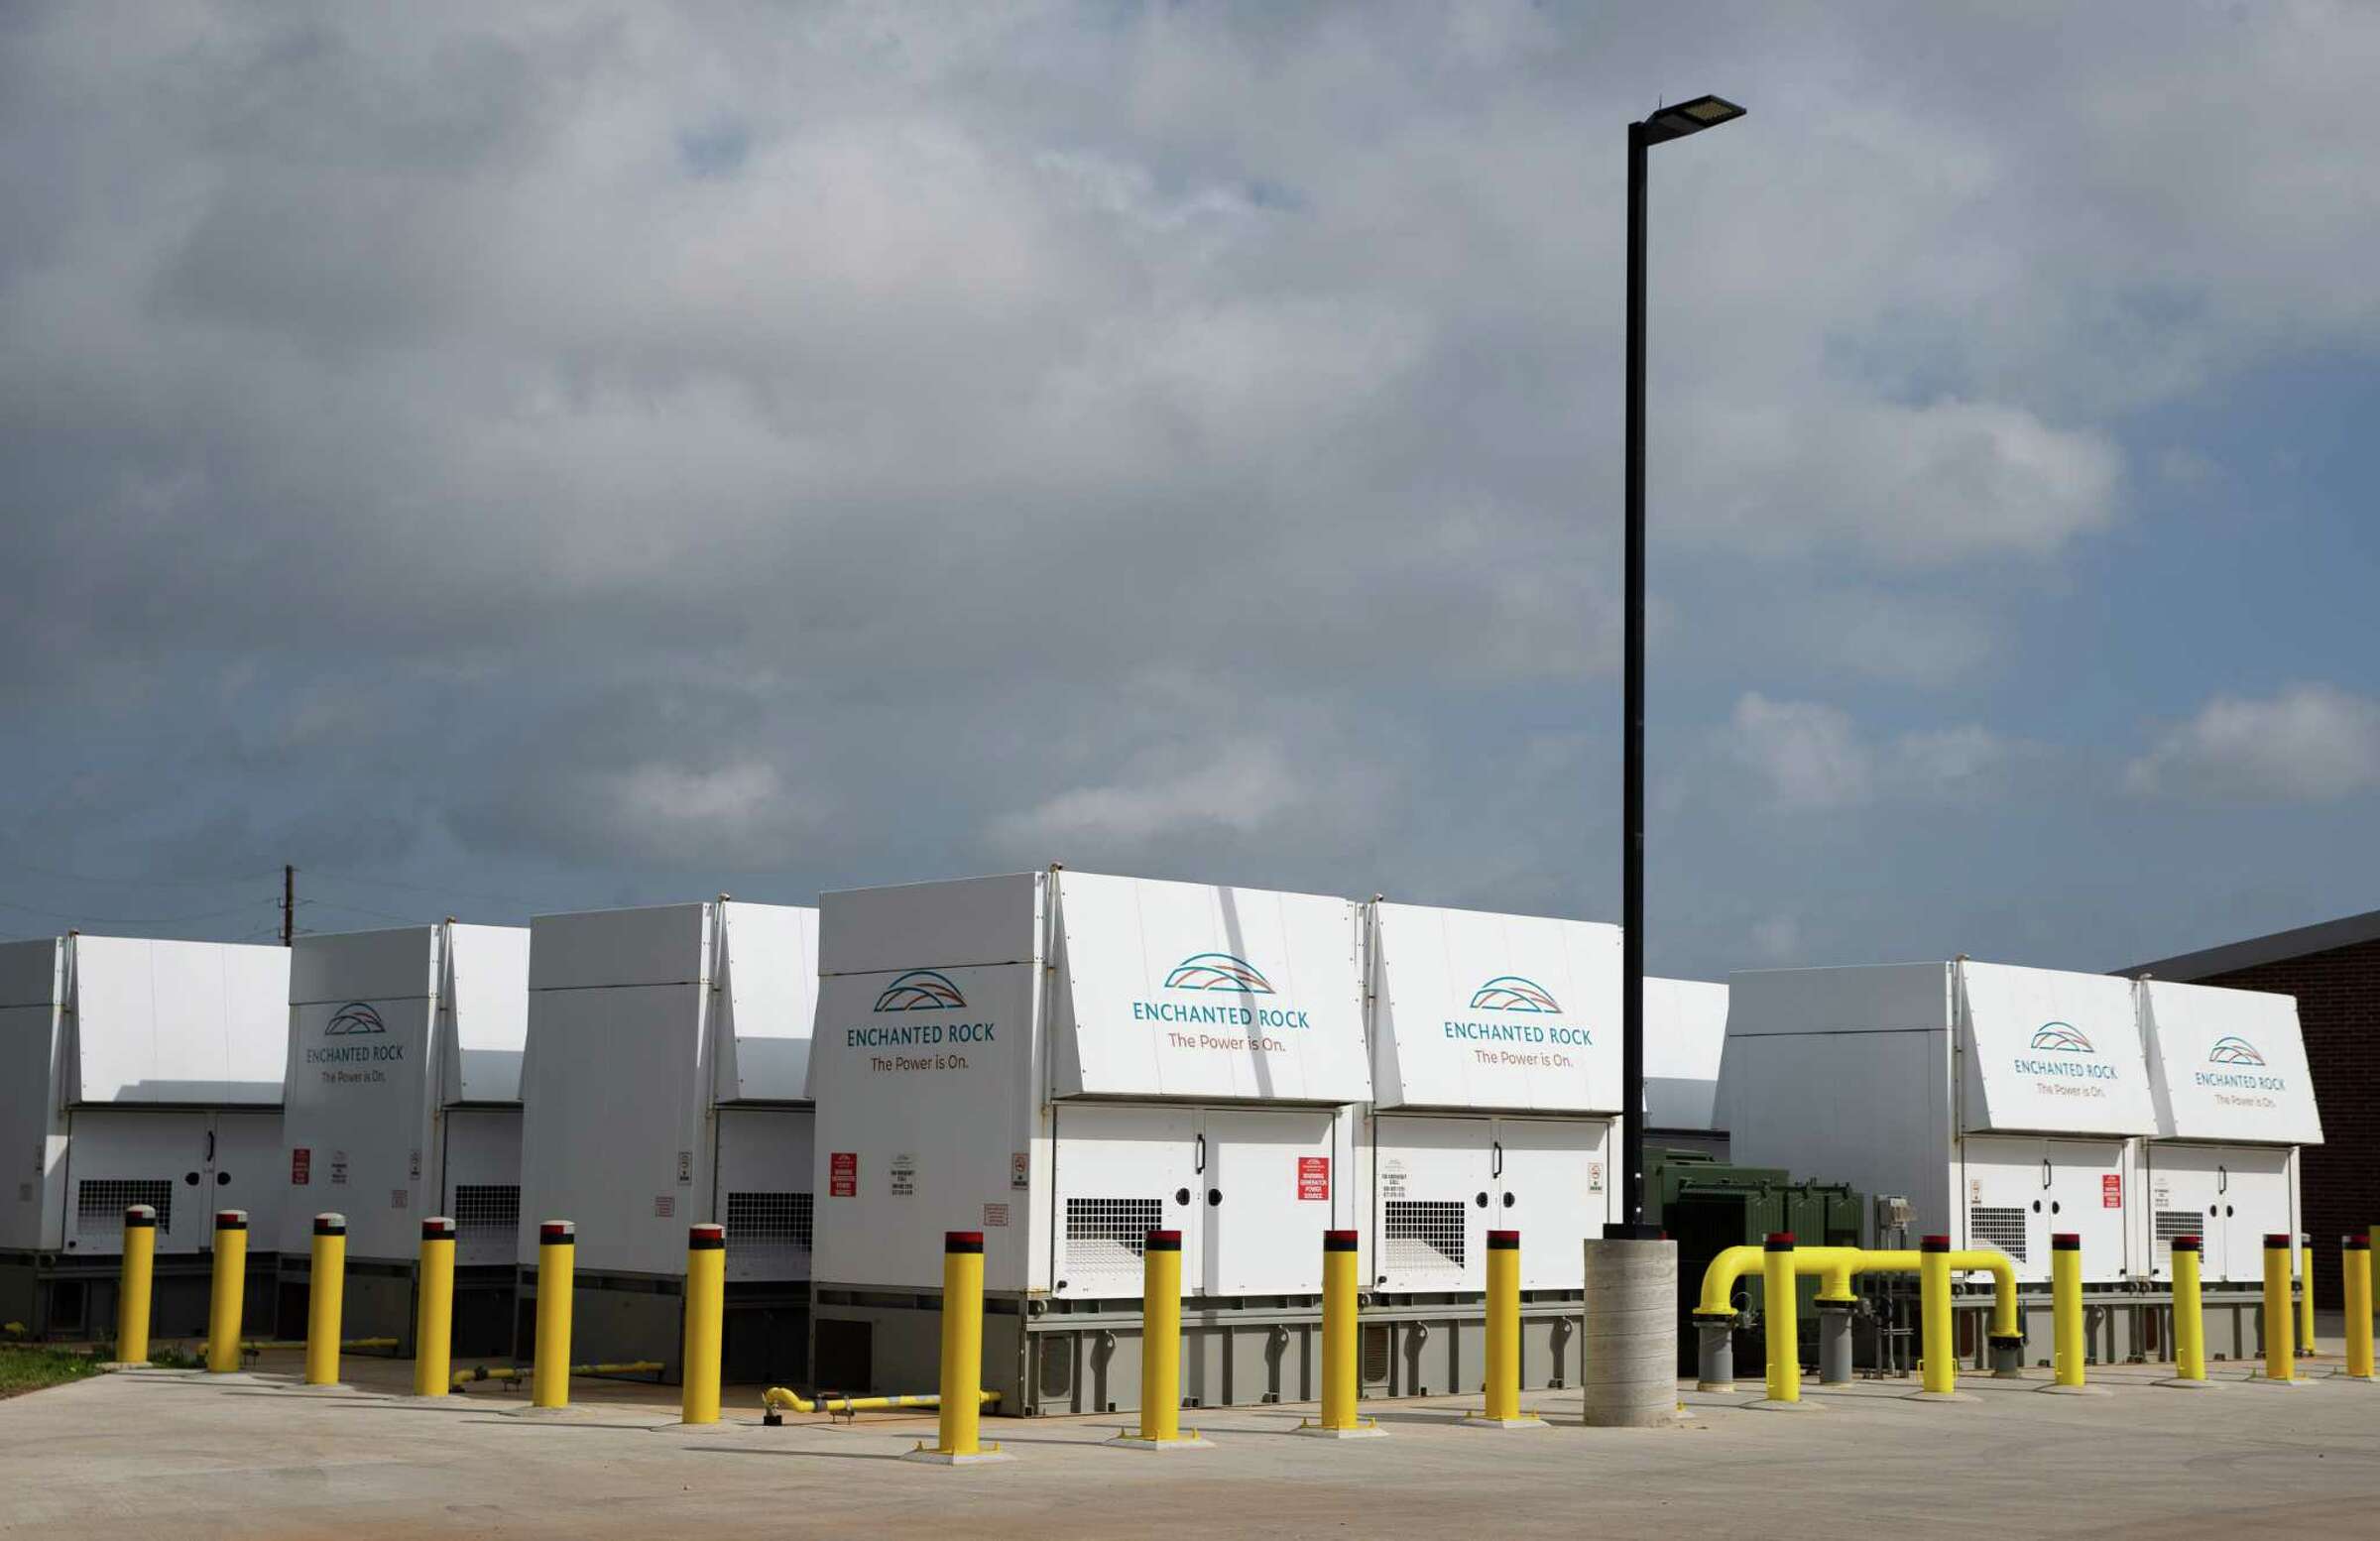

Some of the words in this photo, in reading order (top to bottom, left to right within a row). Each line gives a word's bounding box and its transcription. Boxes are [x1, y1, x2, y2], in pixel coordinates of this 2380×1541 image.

[1132, 1002, 1251, 1025] ENCHANTED
[1259, 1008, 1310, 1029] ROCK
[847, 1024, 942, 1047] ENCHANTED
[949, 1022, 995, 1042] ROCK
[1168, 1032, 1196, 1048] The
[1200, 1034, 1244, 1050] Power
[1248, 1035, 1259, 1051] is
[1262, 1037, 1286, 1052] On.
[1444, 1021, 1544, 1043] ENCHANTED
[1550, 1027, 1593, 1046] ROCK
[306, 1046, 371, 1063] ENCHANTED
[373, 1045, 405, 1061] ROCK
[871, 1057, 892, 1072] The
[895, 1055, 932, 1071] Power
[935, 1054, 945, 1071] is
[948, 1054, 969, 1070] On.
[1476, 1049, 1497, 1064] The
[1501, 1051, 1537, 1066] Power
[1541, 1052, 1551, 1067] is
[1553, 1053, 1574, 1068] On.
[337, 1070, 363, 1083] Power
[2014, 1059, 2083, 1077] ENCHANTED
[2086, 1063, 2118, 1079] ROCK
[2054, 1083, 2081, 1096] Power
[2196, 1072, 2256, 1089] ENCHANTED
[2258, 1076, 2286, 1091] ROCK
